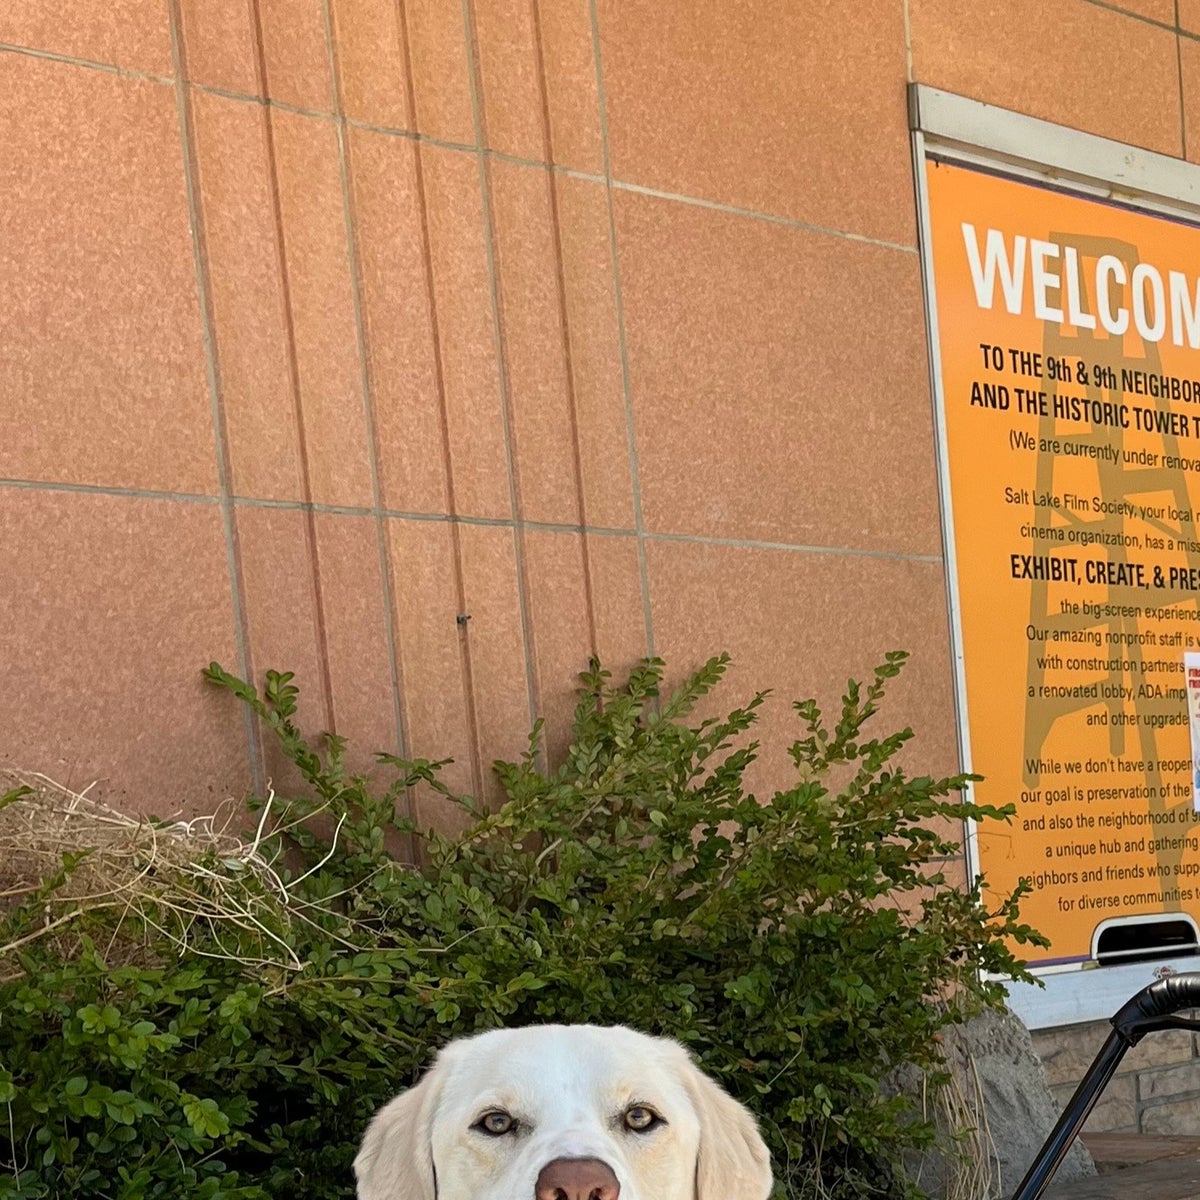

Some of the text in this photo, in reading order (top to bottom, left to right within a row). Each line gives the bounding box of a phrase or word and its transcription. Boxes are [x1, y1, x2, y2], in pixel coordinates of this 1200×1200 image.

[980, 344, 1004, 371] TO
[1008, 349, 1043, 378] THE
[1047, 356, 1072, 383] 9th
[1076, 361, 1090, 386] &
[1093, 364, 1117, 390] 9th
[970, 382, 1009, 410] AND
[1014, 388, 1048, 416] THE
[1053, 394, 1130, 429] HISTORIC
[1133, 407, 1189, 437] TOWER
[1010, 429, 1036, 450] (We
[1040, 439, 1060, 453] are
[1063, 442, 1119, 465] currently
[1123, 449, 1159, 466] under
[1005, 487, 1029, 505] Salt
[1033, 490, 1060, 508] Lake
[1064, 493, 1089, 511] Film
[1092, 497, 1137, 519] Society,
[1140, 505, 1165, 520] your
[1168, 505, 1193, 522] local
[1020, 522, 1064, 541] cinema
[1068, 529, 1142, 550] organization,
[1145, 534, 1164, 549] has
[1167, 539, 1173, 550] a
[1011, 554, 1081, 586] EXHIBIT,
[1086, 560, 1149, 590] CREATE,
[1153, 565, 1165, 588] &
[1060, 599, 1079, 615] the
[1083, 601, 1141, 619] big-screen
[1026, 625, 1049, 641] Our
[1052, 628, 1101, 646] amazing
[1105, 631, 1157, 647] nonprofit
[1159, 631, 1182, 646] staff
[1185, 632, 1194, 646] is
[1037, 654, 1185, 675] with construction partners
[1028, 685, 1035, 697] a
[1039, 684, 1098, 698] renovated
[1101, 684, 1135, 702] lobby,
[1138, 684, 1162, 699] ADA
[1165, 685, 1187, 702] imp
[1087, 711, 1189, 729] and other upgrade
[1026, 758, 1061, 774] While
[1064, 762, 1082, 773] we
[1085, 758, 1114, 773] don't
[1118, 758, 1144, 772] have
[1147, 761, 1153, 771] a
[1021, 783, 1190, 806] our goal is preservation of the
[1023, 815, 1045, 831] and
[1049, 815, 1073, 829] also
[1076, 813, 1094, 827] the
[1098, 808, 1175, 829] neighborhood
[1178, 808, 1189, 822] of
[1045, 846, 1052, 858] a
[1056, 841, 1096, 859] unique
[1099, 839, 1121, 854] hub
[1124, 837, 1145, 852] and
[1148, 834, 1198, 854] gathering
[1081, 866, 1103, 883] and
[1106, 864, 1145, 881] friends
[1147, 862, 1170, 877] who
[1058, 896, 1075, 911] for
[1078, 894, 1120, 910] diverse
[1123, 887, 1192, 906] communities
